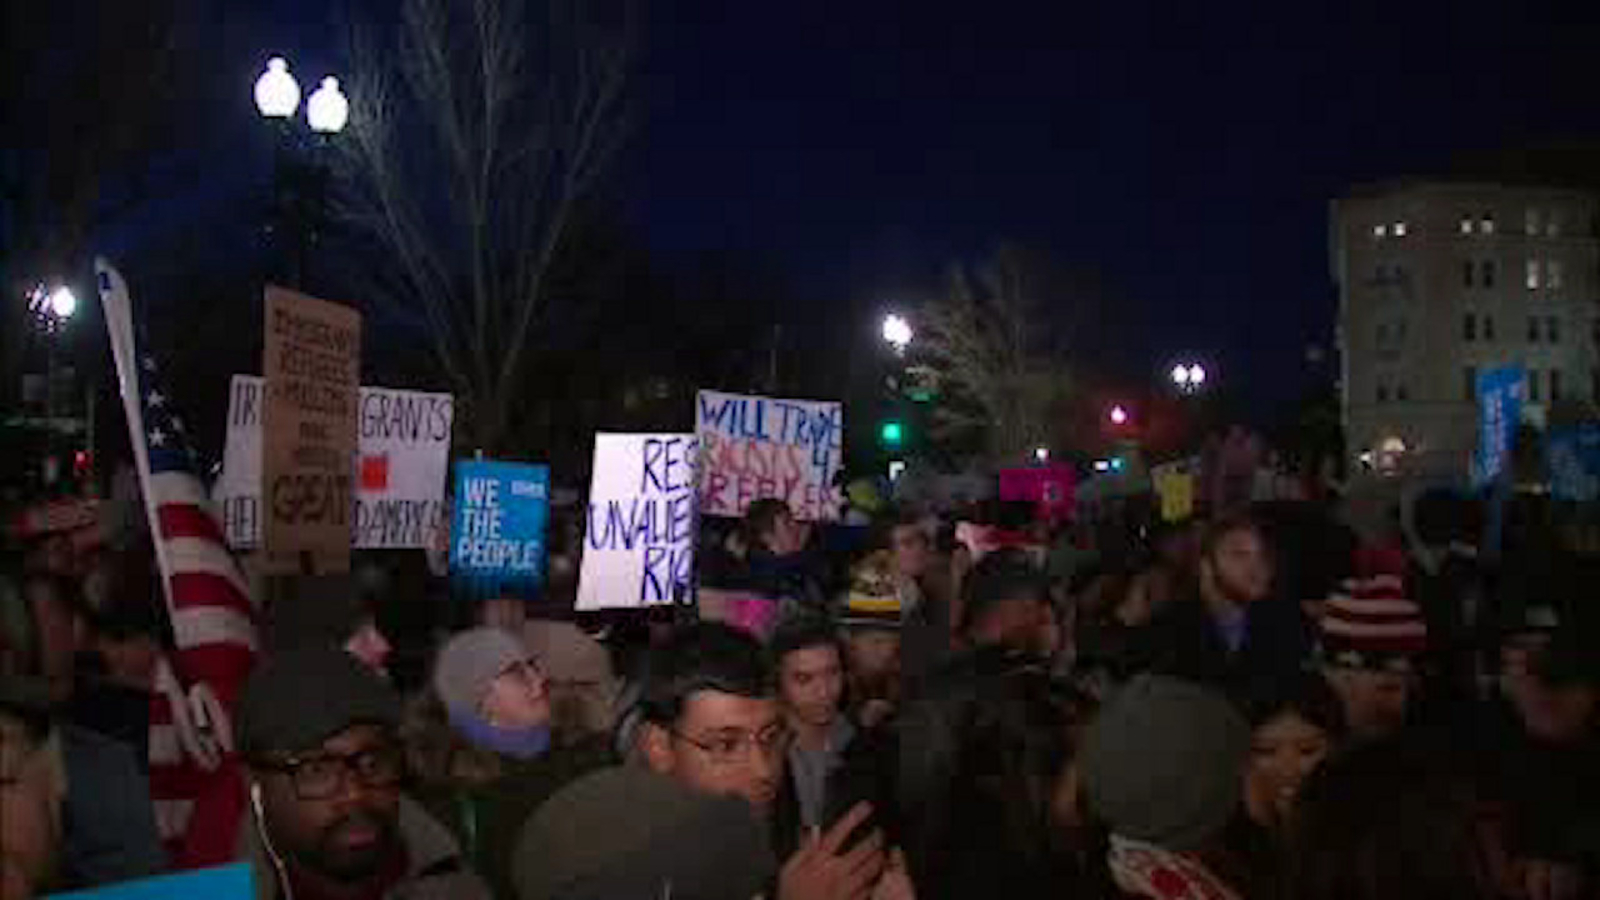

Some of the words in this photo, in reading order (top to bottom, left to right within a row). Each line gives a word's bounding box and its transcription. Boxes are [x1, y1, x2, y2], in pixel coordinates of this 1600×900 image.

[700, 393, 770, 440] WILL
[463, 476, 501, 508] WE
[461, 507, 502, 539] THE
[457, 536, 541, 570] PEOPLE
